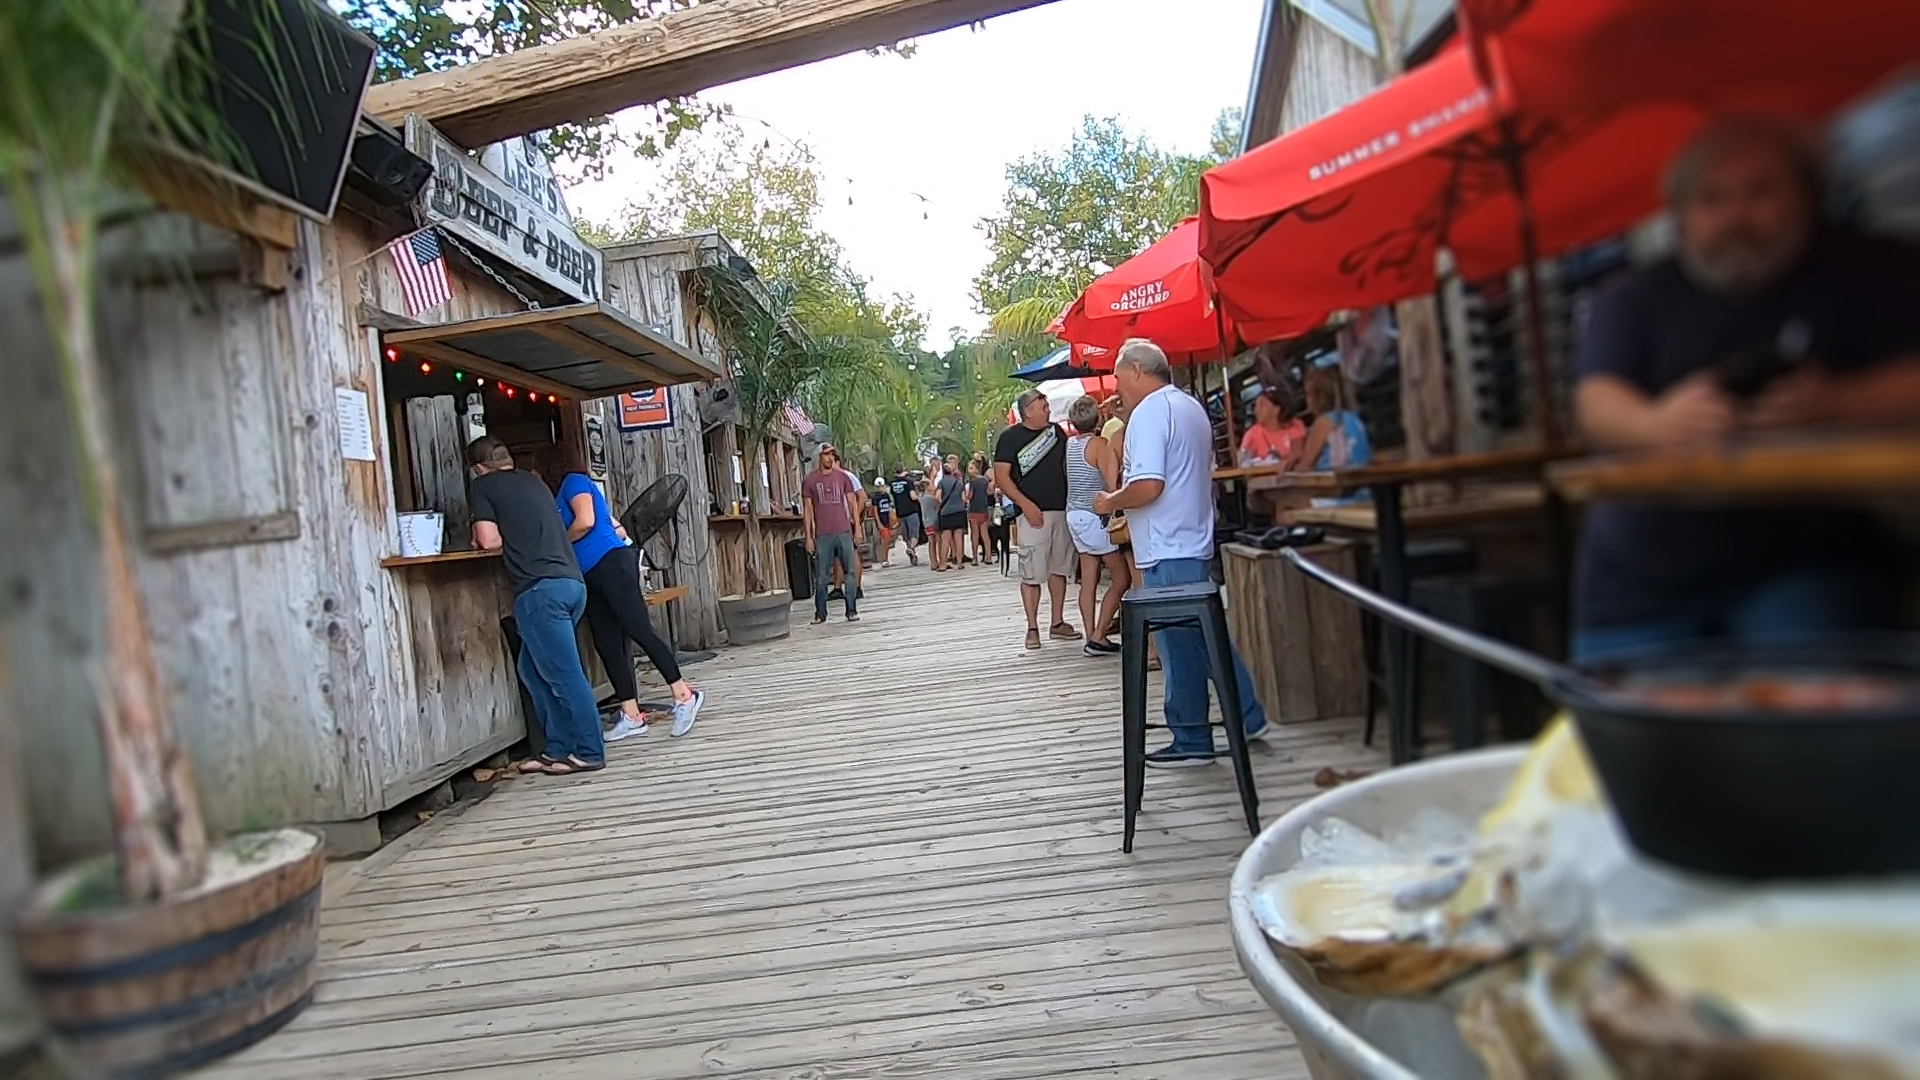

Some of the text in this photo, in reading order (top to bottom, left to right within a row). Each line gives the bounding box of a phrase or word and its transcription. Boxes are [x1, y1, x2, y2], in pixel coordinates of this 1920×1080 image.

[502, 141, 557, 216] LEE'S
[1308, 130, 1401, 181] SUMMER
[430, 143, 599, 300] BEEF & BEER
[1110, 290, 1170, 311] ORCHARD
[1120, 280, 1164, 303] ANGRY
